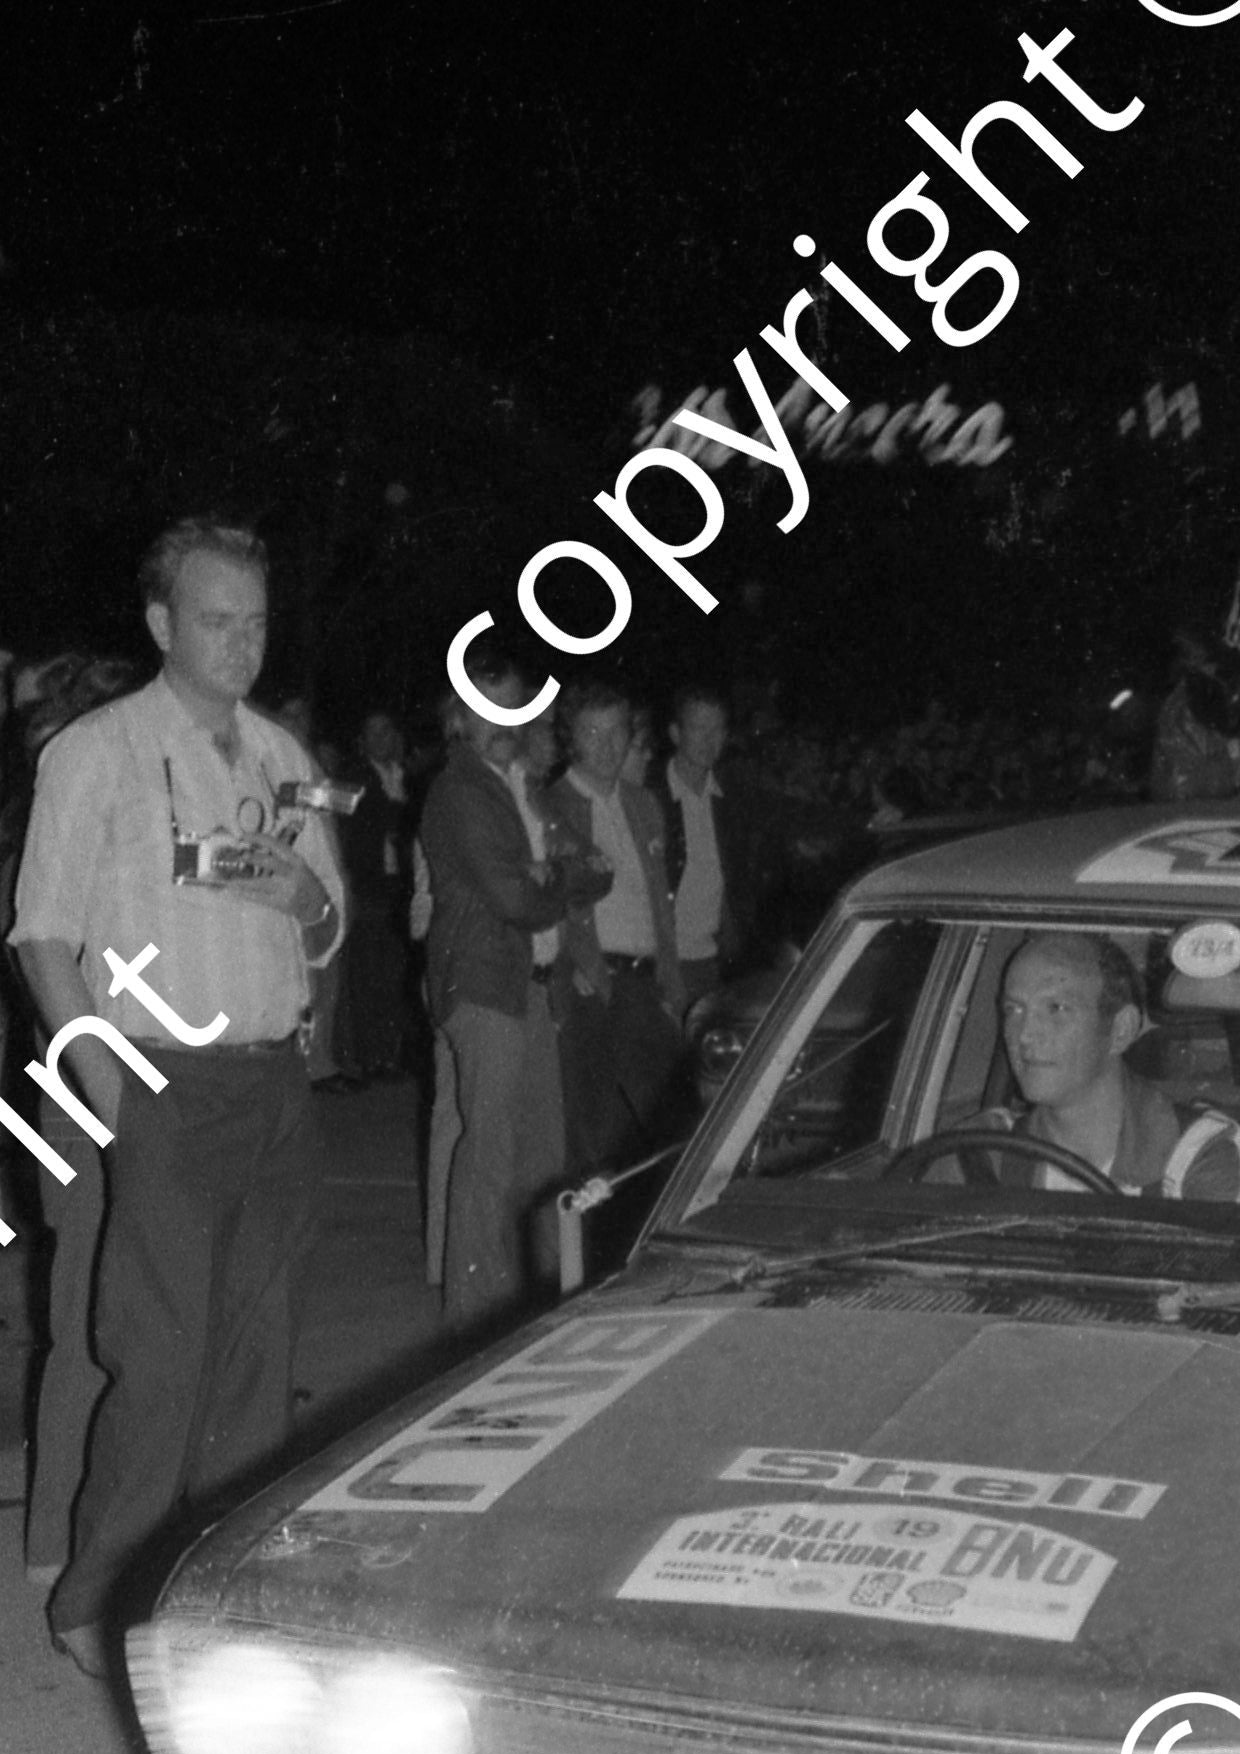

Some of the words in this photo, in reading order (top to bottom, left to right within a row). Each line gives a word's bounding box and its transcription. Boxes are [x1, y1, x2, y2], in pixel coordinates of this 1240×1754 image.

[744, 1450, 1150, 1515] Shell
[779, 1513, 863, 1541] RALI
[891, 1518, 940, 1538] 19
[678, 1529, 928, 1572] INTERNACIONAL
[939, 1522, 1096, 1587] BNU
